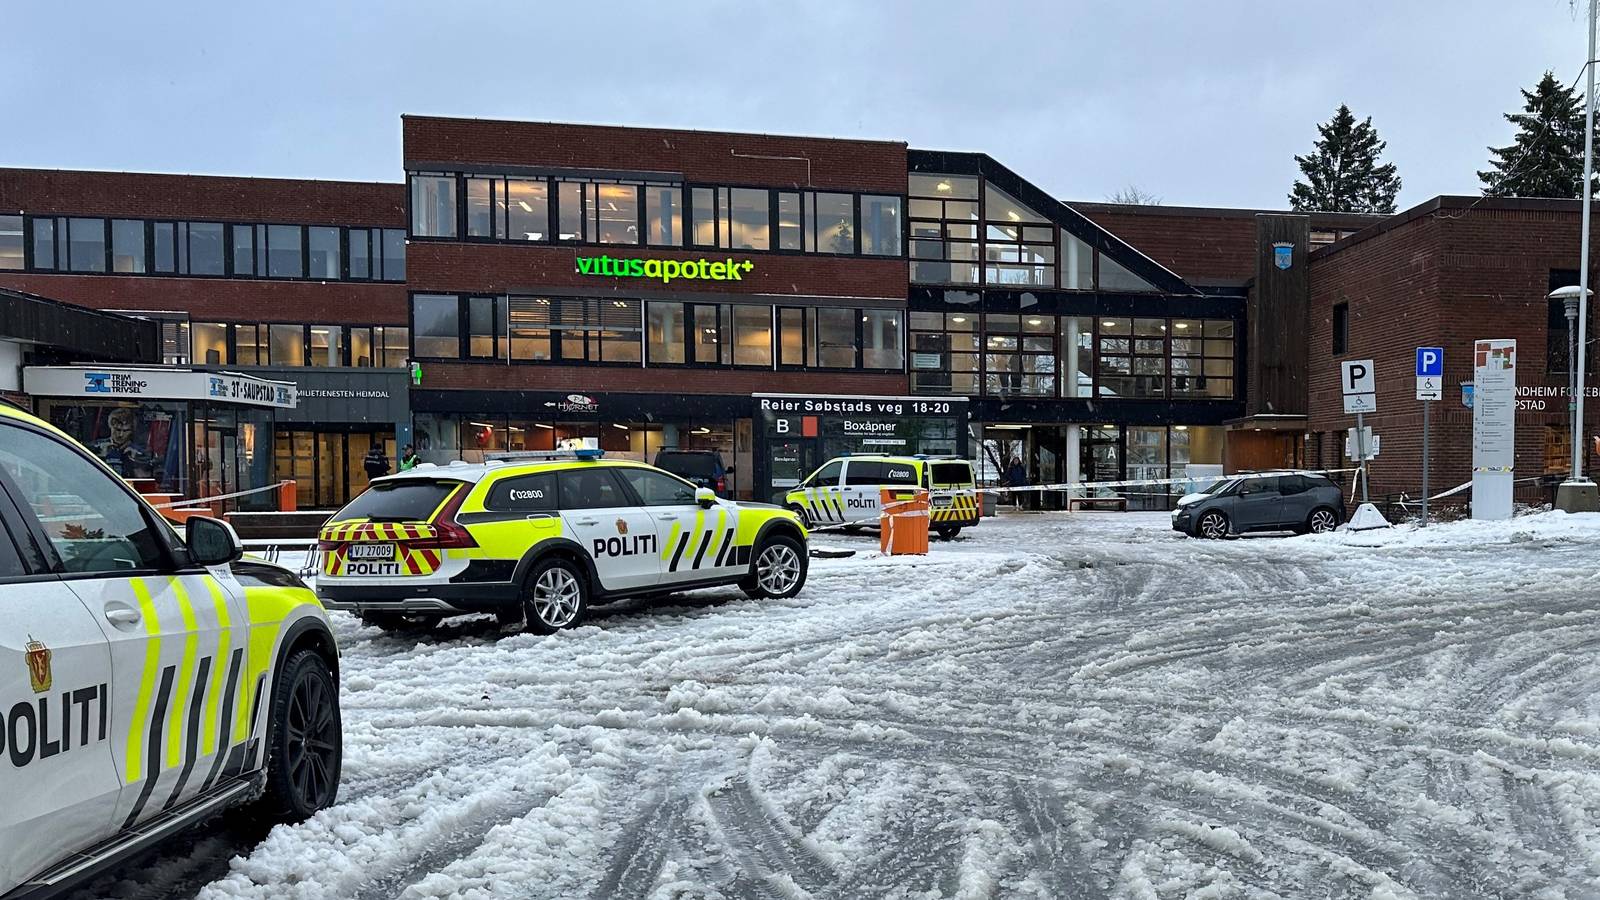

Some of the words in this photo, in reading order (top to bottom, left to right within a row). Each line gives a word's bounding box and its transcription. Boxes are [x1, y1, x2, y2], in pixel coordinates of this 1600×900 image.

[1422, 351, 1437, 373] P
[111, 373, 131, 381] TRIM
[1349, 364, 1367, 389] P
[111, 380, 148, 388] TRENING
[111, 386, 142, 394] TRIVSEL
[356, 390, 390, 398] HEIMDAL
[760, 399, 800, 411] Reier
[804, 400, 873, 413] Søbstads
[877, 403, 903, 415] veg
[912, 402, 950, 414] 18-20
[776, 419, 790, 433] B
[843, 420, 897, 433] Boxåpner
[1107, 446, 1116, 459] A
[516, 489, 544, 499] 02800
[847, 498, 876, 509] POLITI
[354, 545, 364, 557] VJ
[366, 545, 392, 557] 27009
[593, 534, 657, 559] POLITI
[346, 563, 400, 575] POLITI
